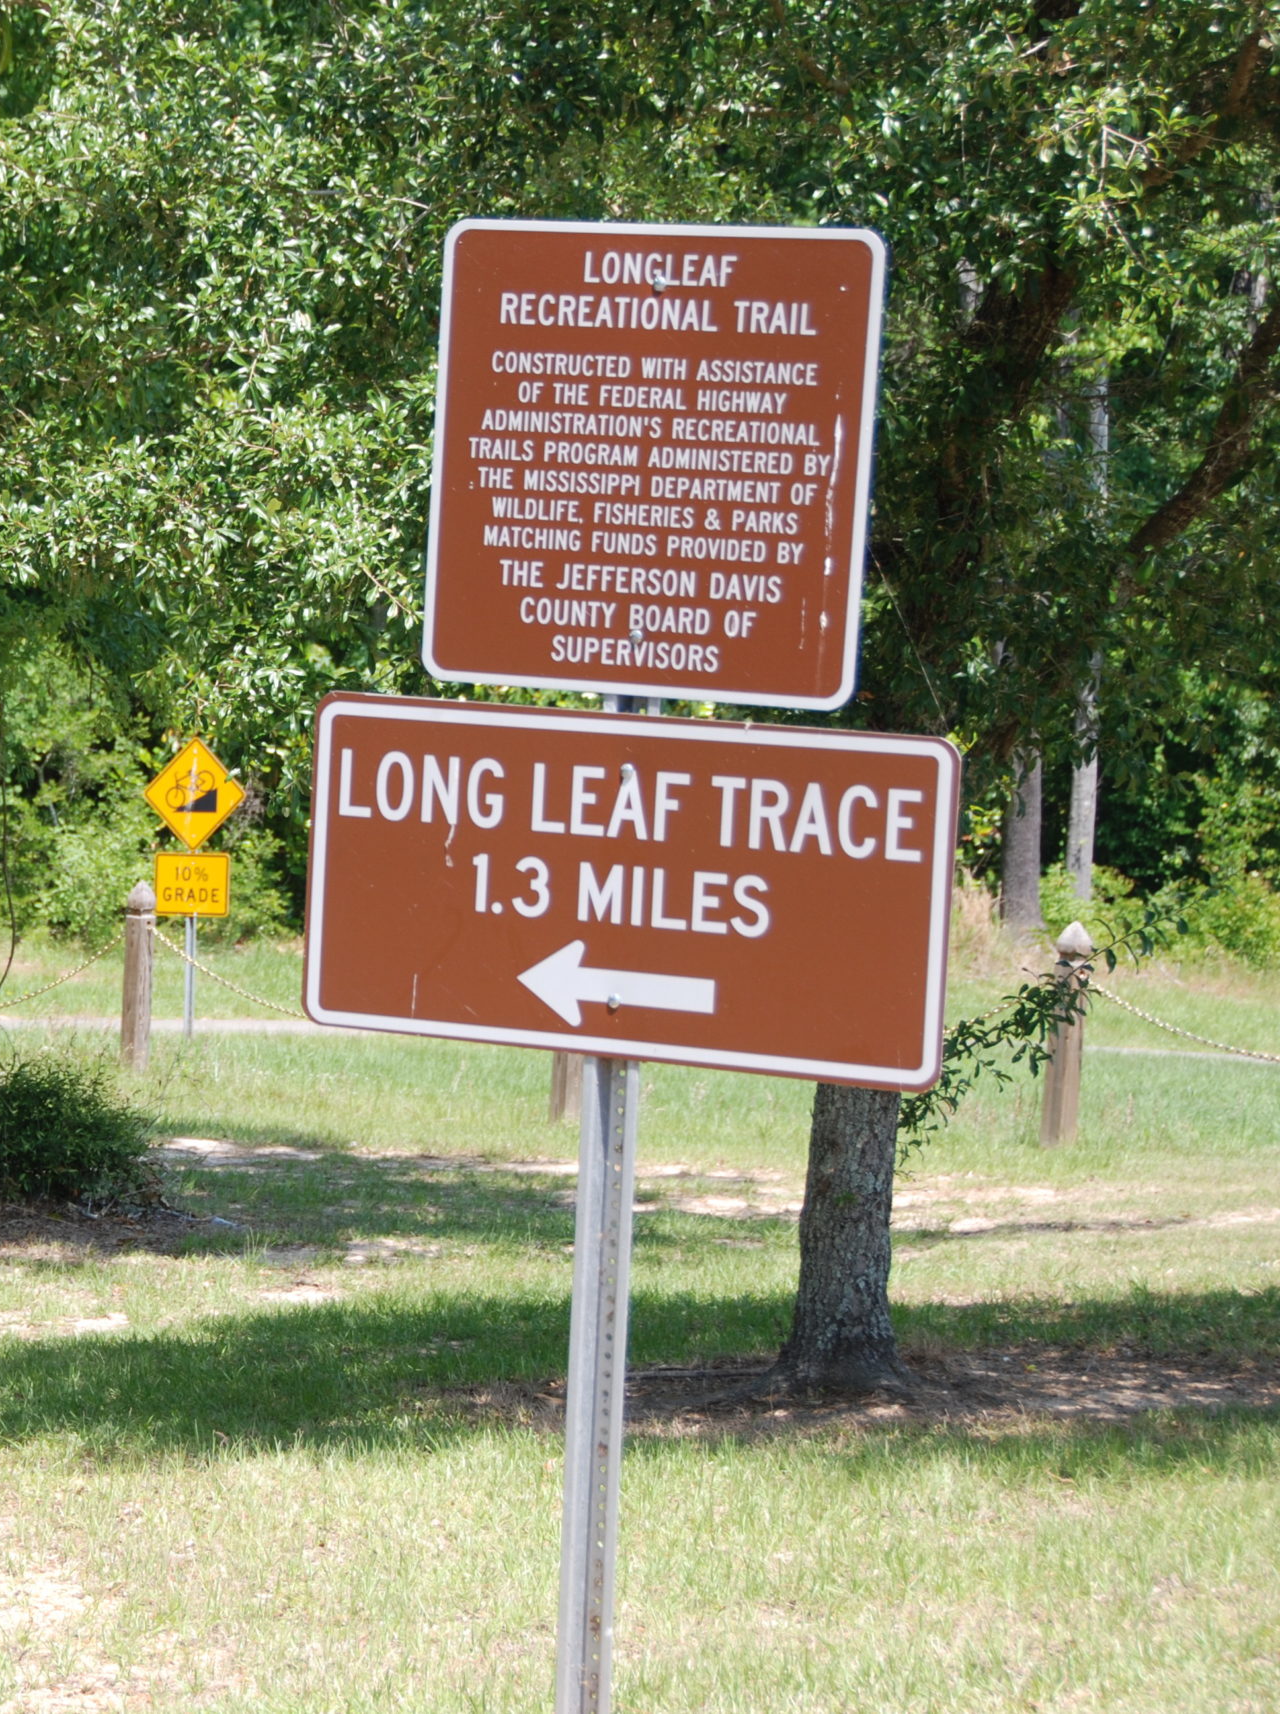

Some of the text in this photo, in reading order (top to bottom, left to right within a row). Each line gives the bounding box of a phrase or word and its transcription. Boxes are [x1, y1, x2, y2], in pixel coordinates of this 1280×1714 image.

[584, 250, 739, 288] LONGLEAF
[499, 293, 817, 336] RECREATIONAL TRAIL
[491, 351, 818, 386] CONSTRUCTED WITH ASSISTANCE
[518, 381, 788, 415] OF THE FEDERAL HIGHWAY
[481, 409, 820, 446] ADMINISTRATION'S RECREATIONAL
[468, 437, 831, 477] TRAILS PROGRAM ADMINISTERED BY
[478, 466, 818, 506] THE MISSISSIPPI DEPARTMENT OF
[491, 496, 799, 536] WILDLIFE, FISHERIES & PARKS
[483, 525, 804, 565] MATCHING FUNDS PROVIDED BY
[499, 559, 783, 604] THE JEFFERSON DAVIS
[519, 596, 758, 639] COUNTY BOARD OF
[550, 635, 719, 674] SUPERVISORS
[338, 747, 923, 863] LONG LEAF TRACE
[175, 866, 208, 881] 10%
[162, 887, 219, 902] GRADE
[472, 852, 770, 938] 1.3 MILES
